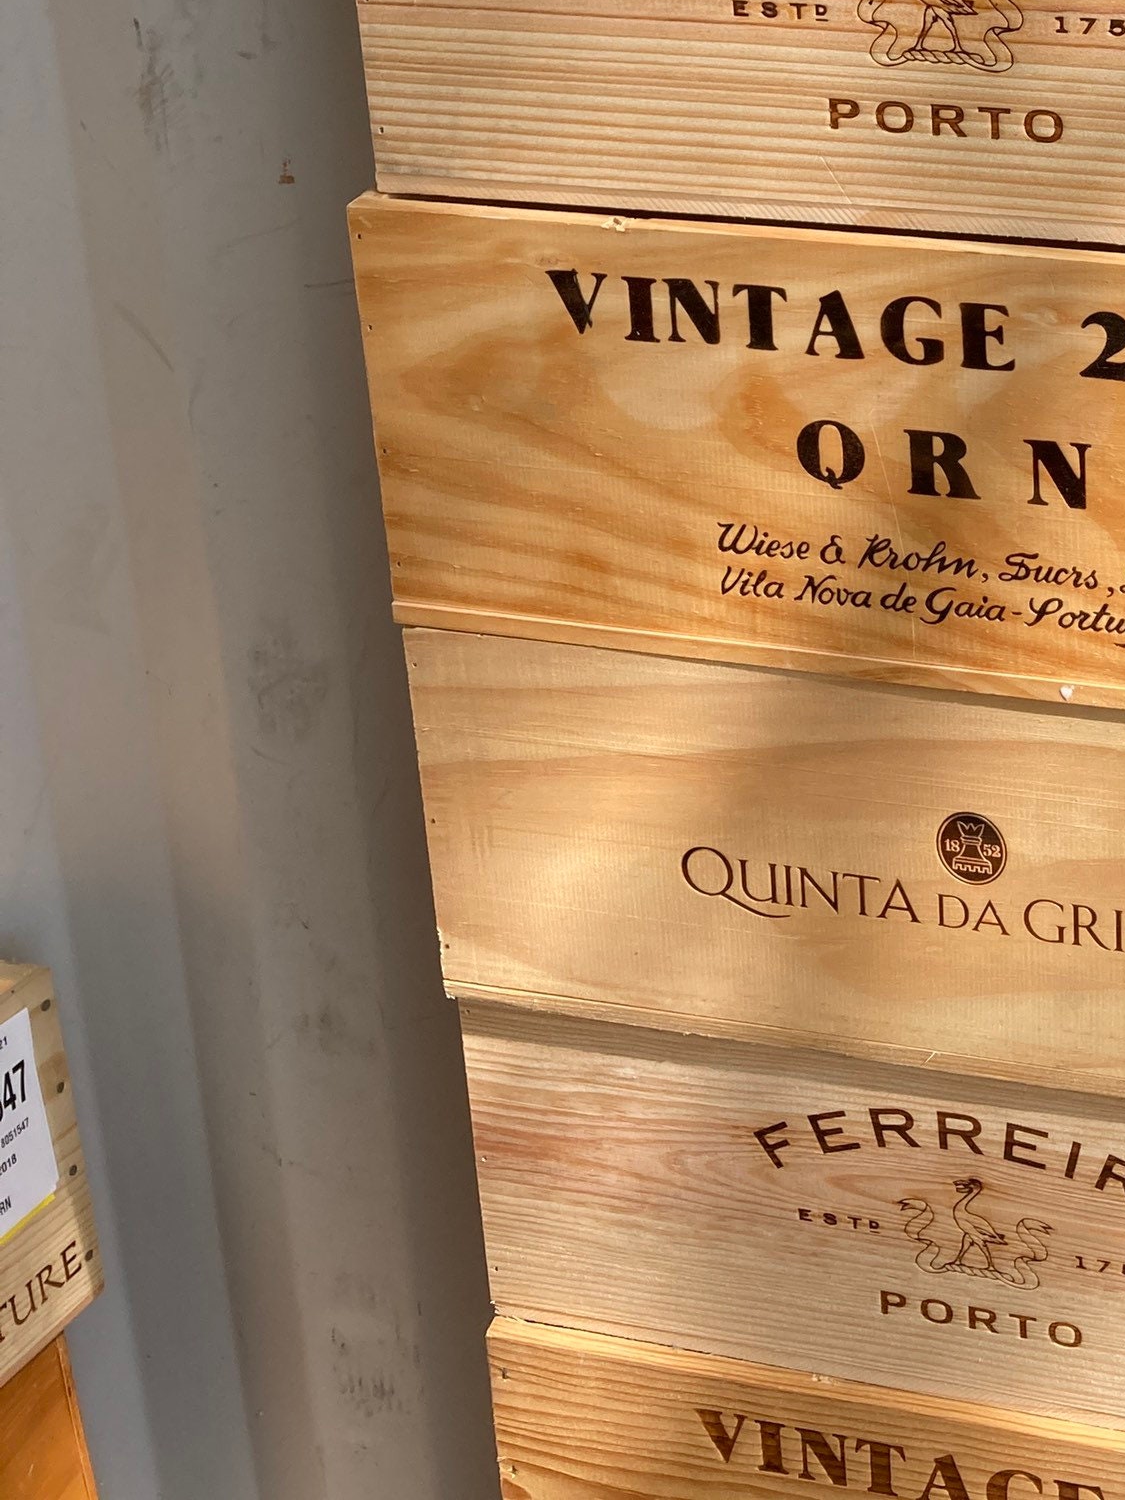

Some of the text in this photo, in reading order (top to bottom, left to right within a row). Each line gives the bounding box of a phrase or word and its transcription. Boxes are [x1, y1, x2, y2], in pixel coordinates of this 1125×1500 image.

[732, 0, 830, 22] ESTD
[827, 97, 1065, 144] PORTO
[545, 268, 1016, 372] VINTAGE
[716, 520, 811, 561] Wiese
[819, 534, 846, 565] &
[857, 533, 989, 585] Krohn,
[720, 565, 784, 599] Vila
[793, 575, 873, 610] Nova
[879, 581, 915, 615] de
[943, 838, 960, 853] 18
[982, 843, 1002, 858] 52
[680, 845, 923, 925] QUINTA
[935, 892, 1011, 936] DA
[0, 1059, 26, 1122] 47
[797, 1207, 881, 1234] ESTD
[880, 1289, 1084, 1349] PORTO
[695, 1406, 1105, 1500] VINTAG
